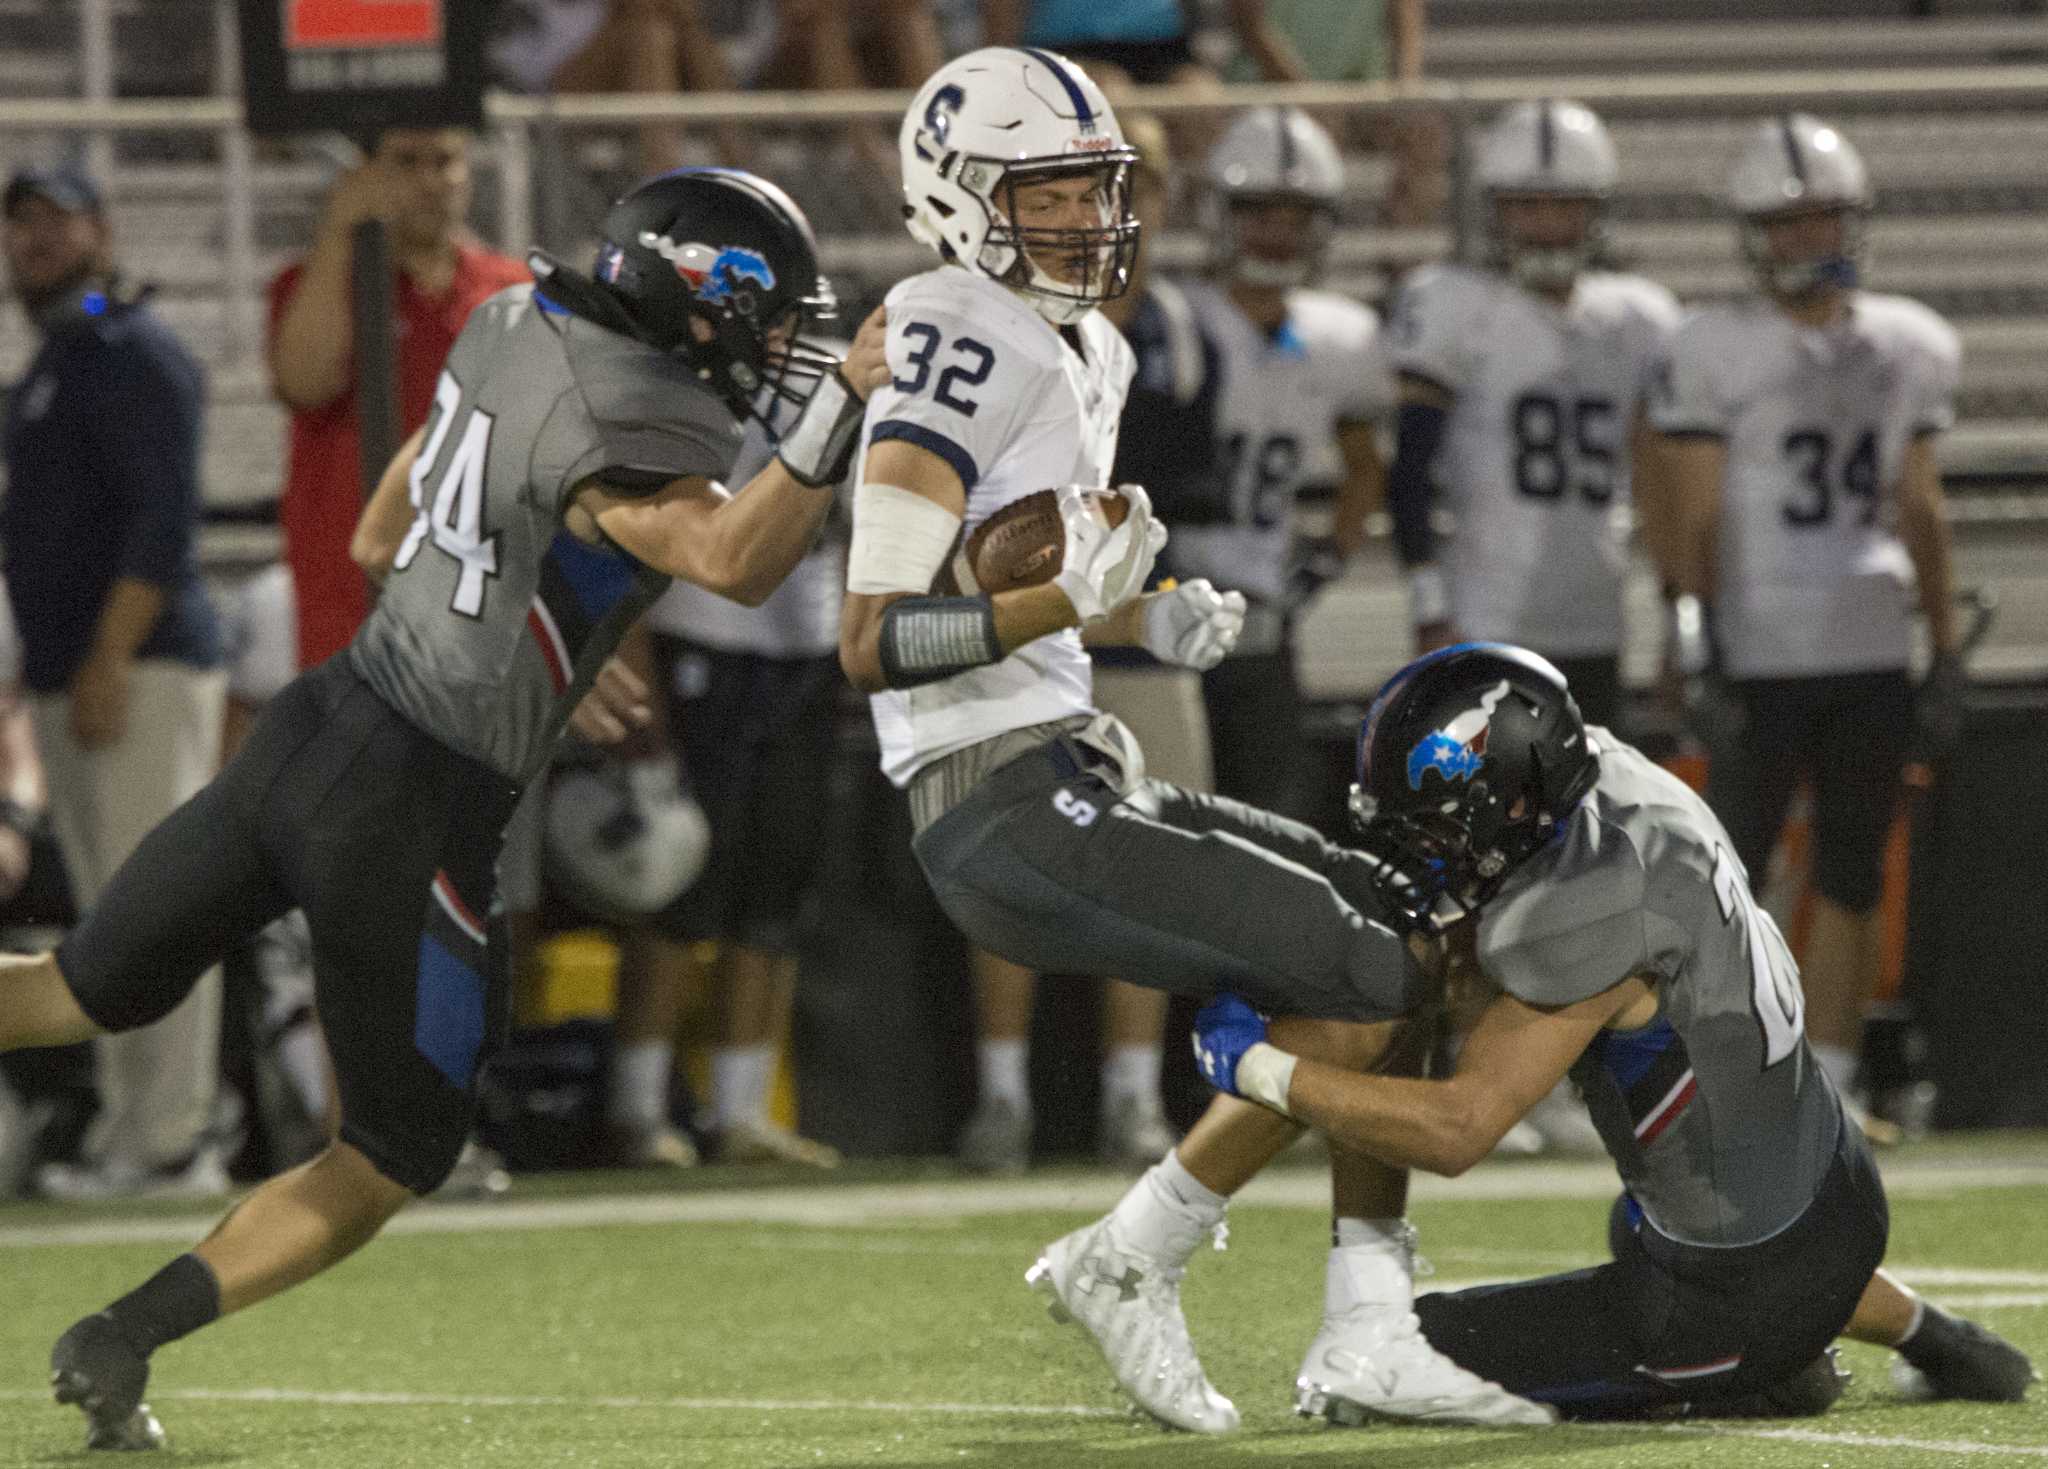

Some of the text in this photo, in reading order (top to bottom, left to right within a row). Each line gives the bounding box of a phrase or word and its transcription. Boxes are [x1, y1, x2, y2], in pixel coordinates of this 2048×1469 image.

[893, 322, 996, 419] 32
[1513, 392, 1614, 507] 85
[1782, 428, 1881, 527] 34
[1053, 788, 1097, 827] S
